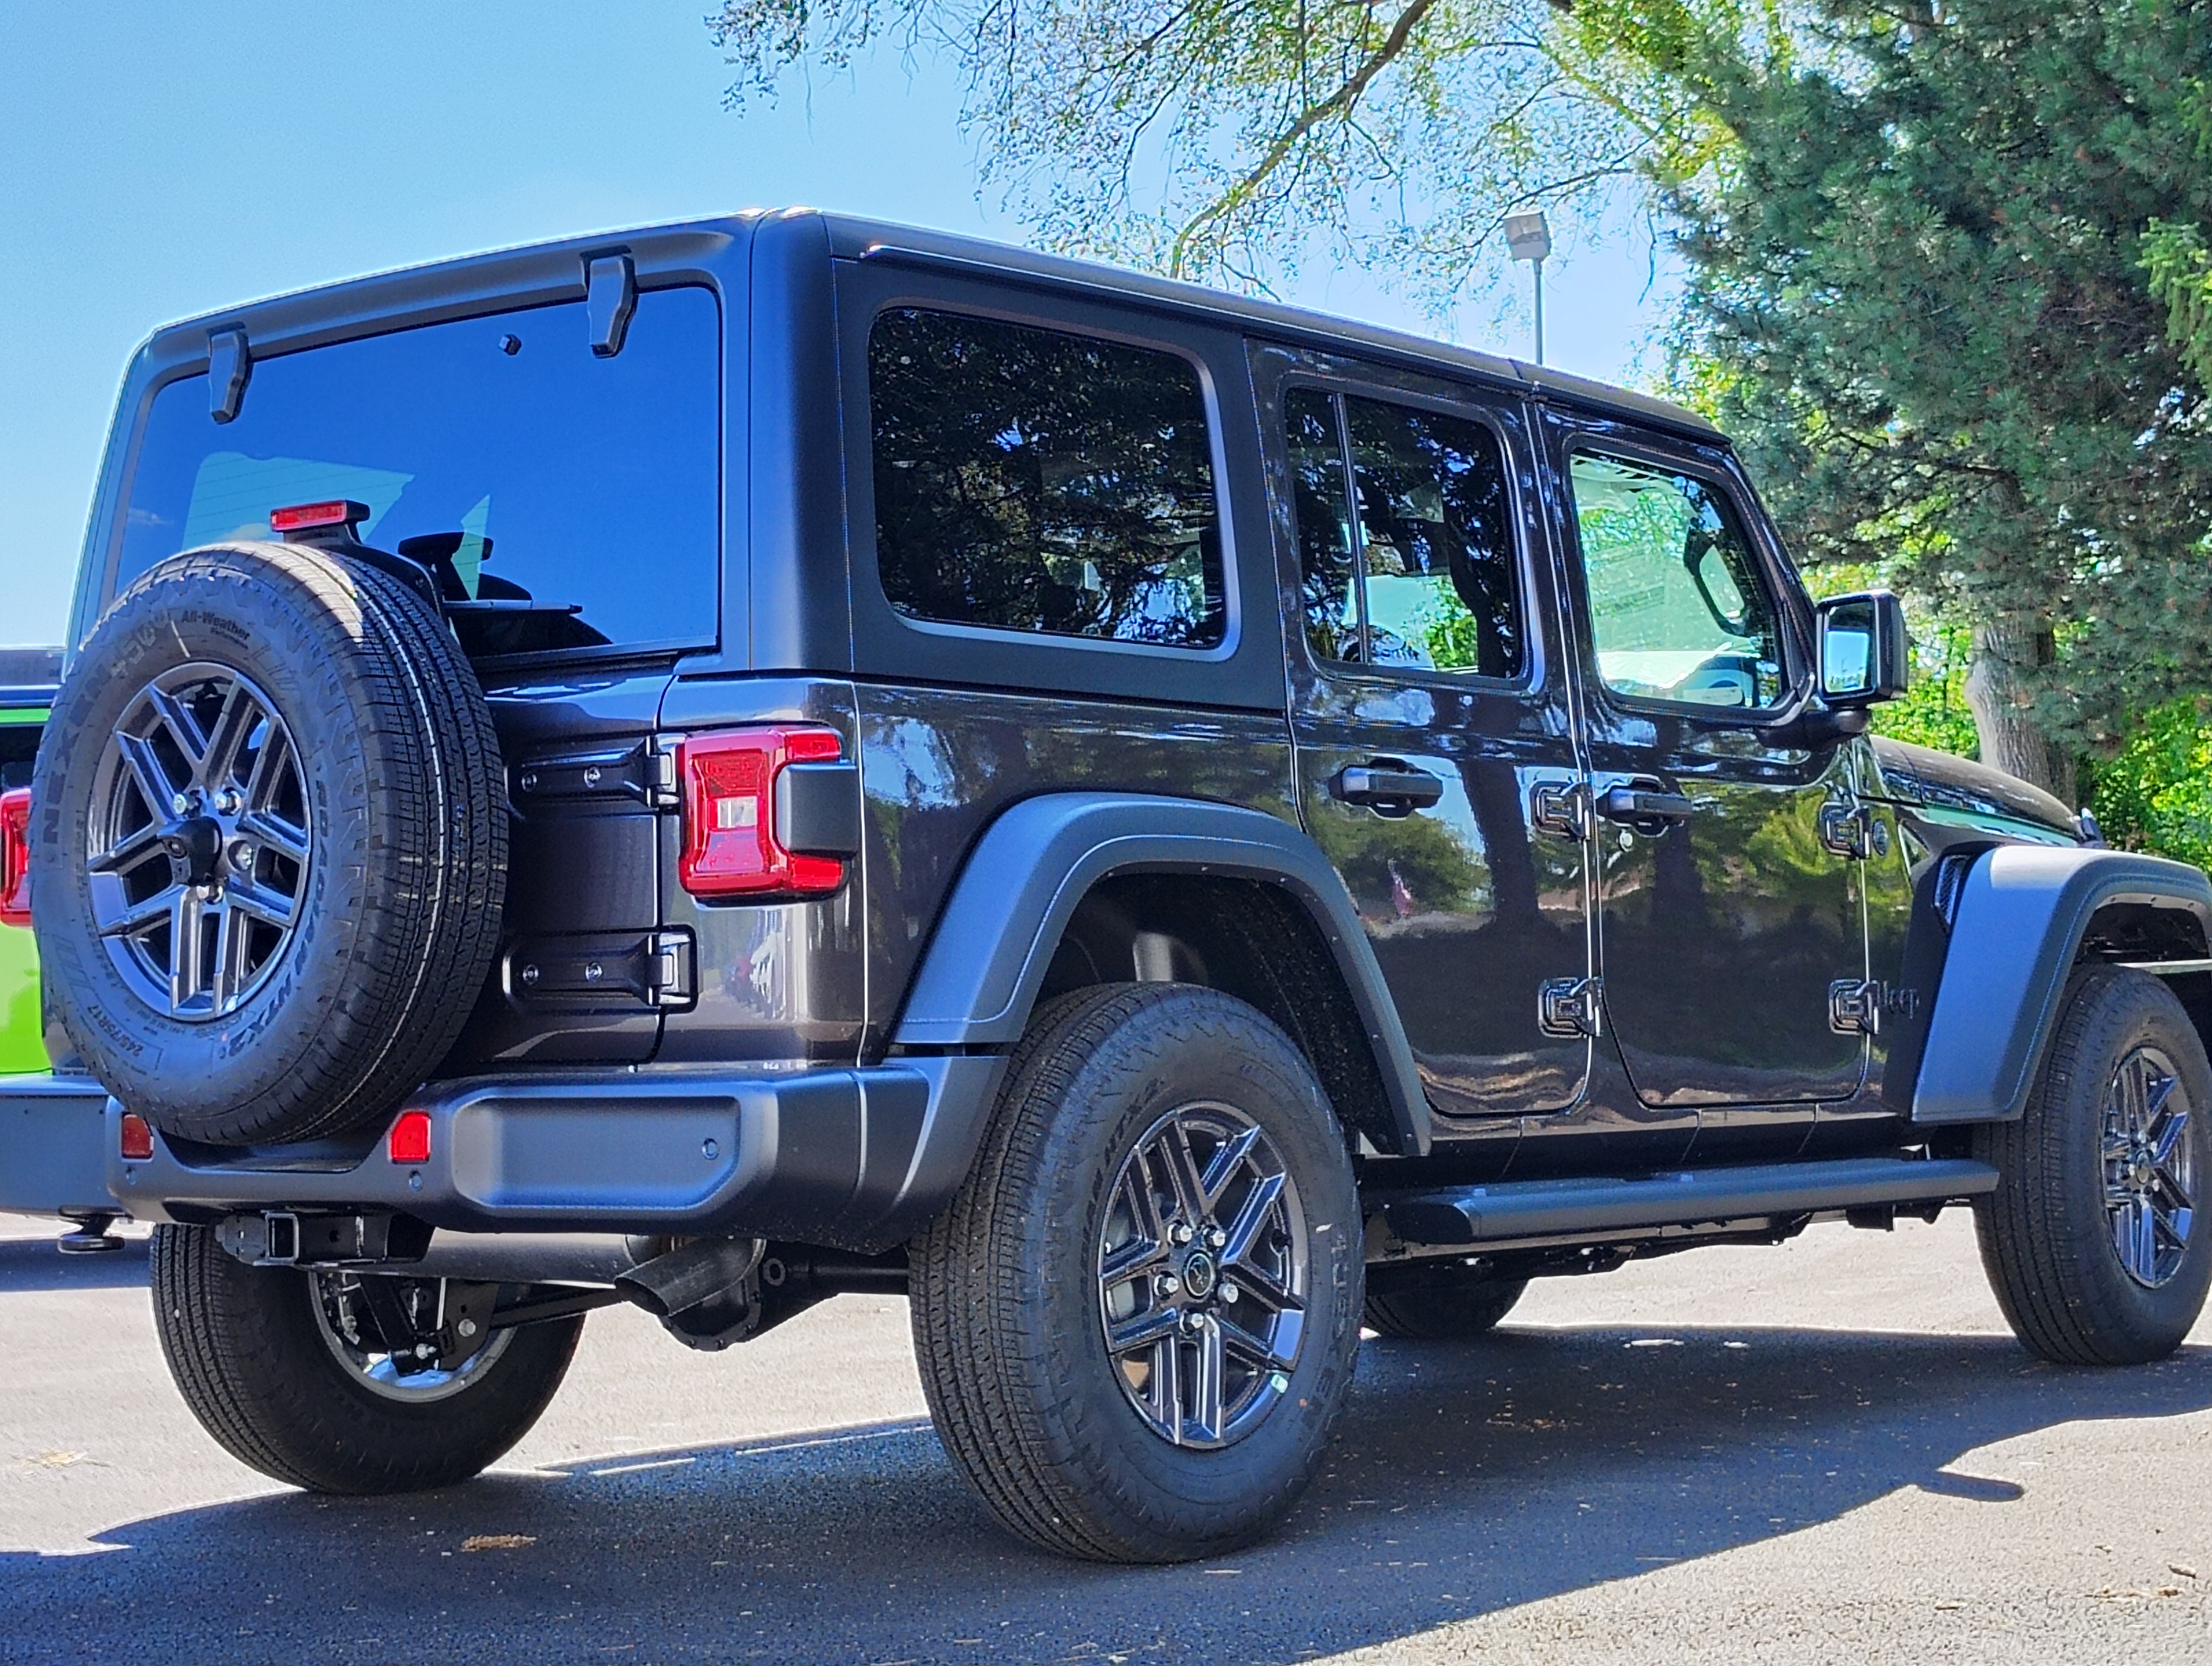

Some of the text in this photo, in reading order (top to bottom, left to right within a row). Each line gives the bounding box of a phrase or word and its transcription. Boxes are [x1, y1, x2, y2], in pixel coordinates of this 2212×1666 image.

[182, 610, 250, 640] All-Weather
[43, 663, 112, 844] NEXEN
[1878, 980, 1920, 1020] Jeep
[87, 1004, 143, 1056] 245/75R17
